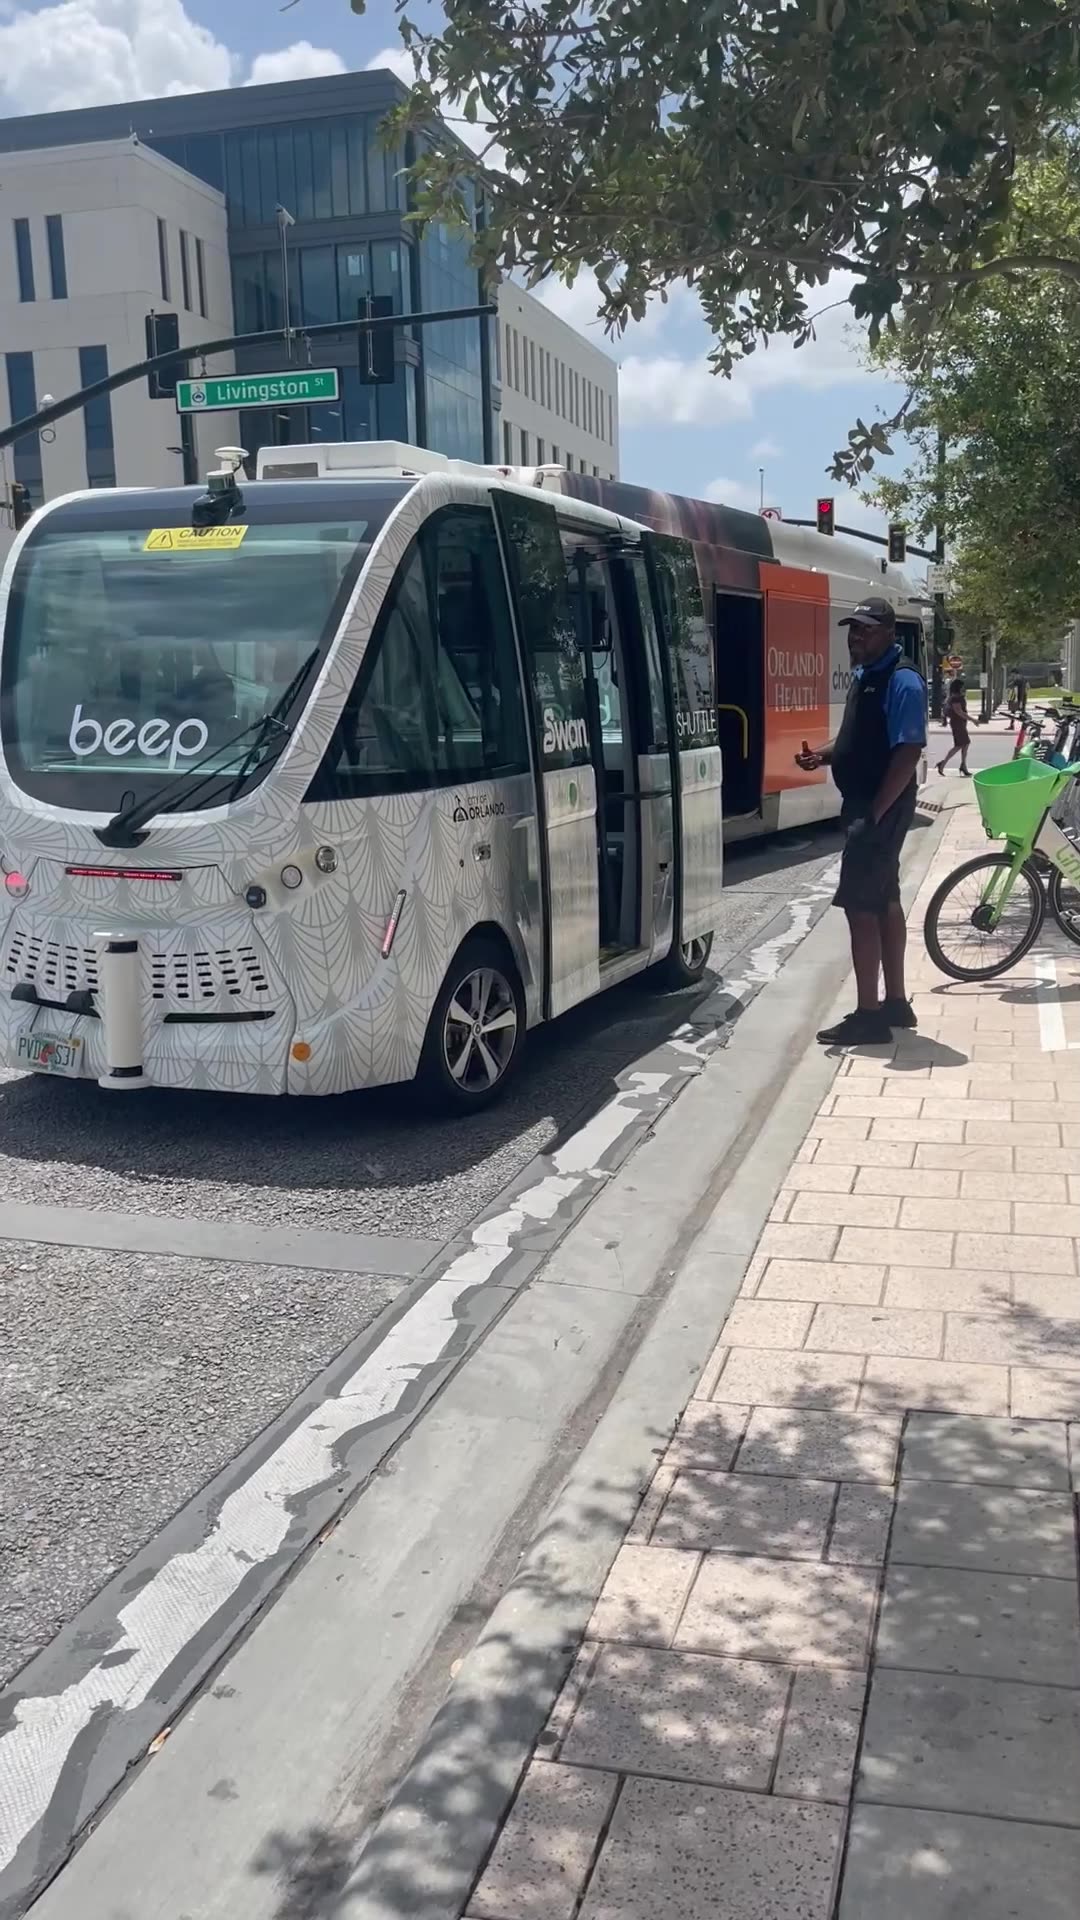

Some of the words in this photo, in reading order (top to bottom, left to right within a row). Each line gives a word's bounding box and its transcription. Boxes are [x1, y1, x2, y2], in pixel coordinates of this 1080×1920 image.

[217, 380, 309, 401] Livingston
[314, 377, 324, 386] St
[179, 527, 242, 538] CAUTION
[767, 646, 824, 677] ORLANDO
[69, 704, 209, 770] beep
[543, 707, 588, 753] Swan
[676, 709, 717, 737] SHUTTLE
[469, 802, 505, 820] ORLANDO
